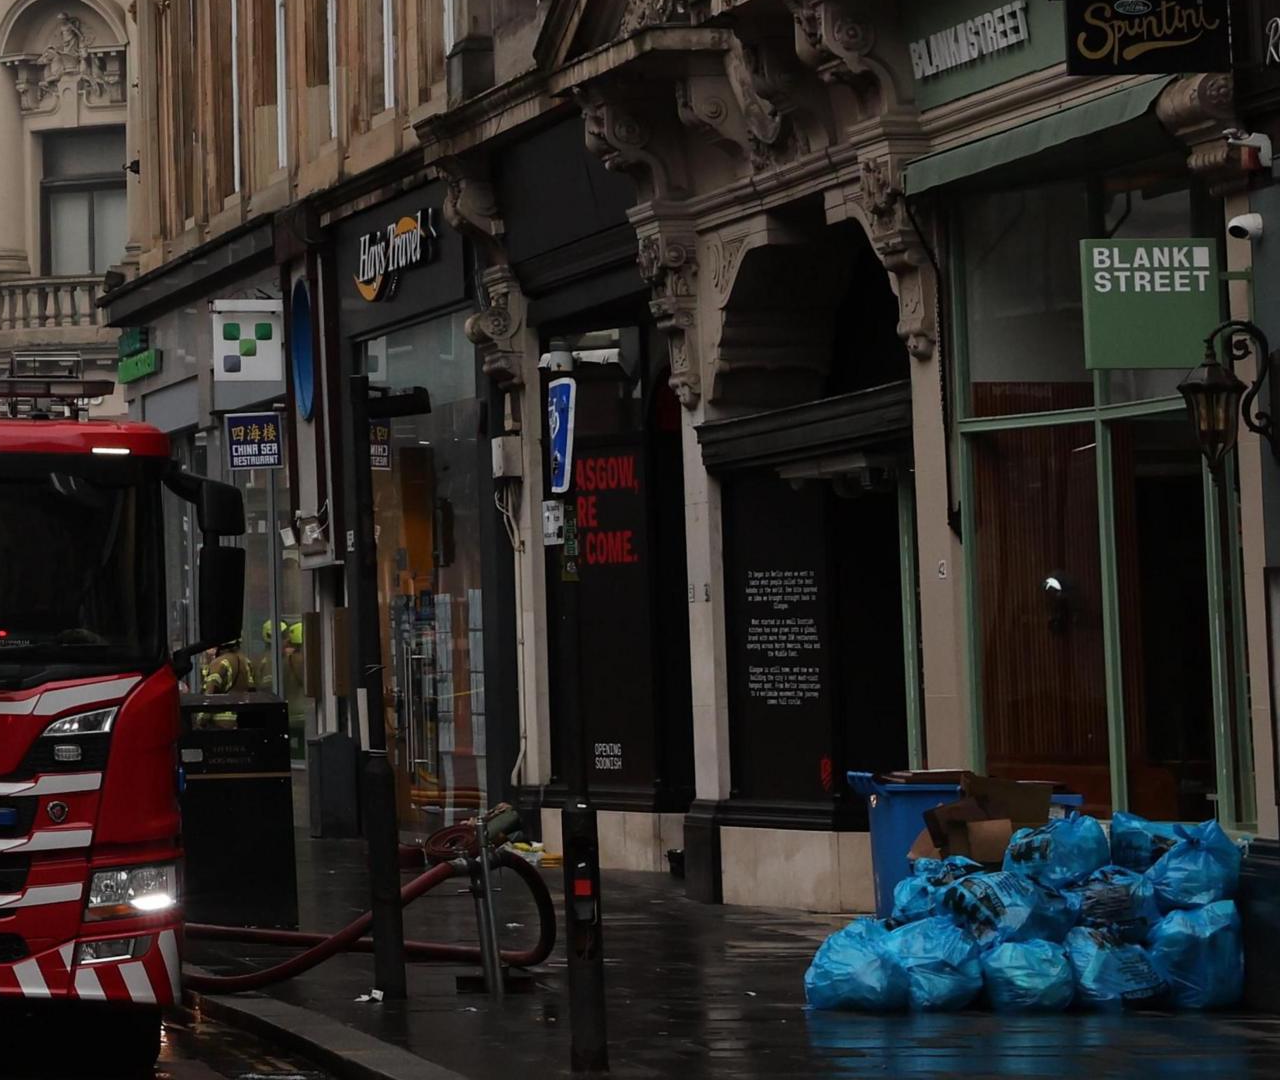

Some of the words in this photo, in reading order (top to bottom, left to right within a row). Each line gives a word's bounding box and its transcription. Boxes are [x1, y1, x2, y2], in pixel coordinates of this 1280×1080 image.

[910, 25, 958, 80] BLANK
[965, 0, 1029, 59] STREET
[359, 232, 386, 290] Hays
[387, 210, 421, 272] Travel
[1092, 246, 1191, 268] BLANK
[1093, 270, 1210, 292] STREET
[231, 423, 277, 443] 四海楼
[232, 444, 259, 456] CHINA
[261, 443, 278, 455] SEA
[233, 454, 279, 466] RESTAURANT
